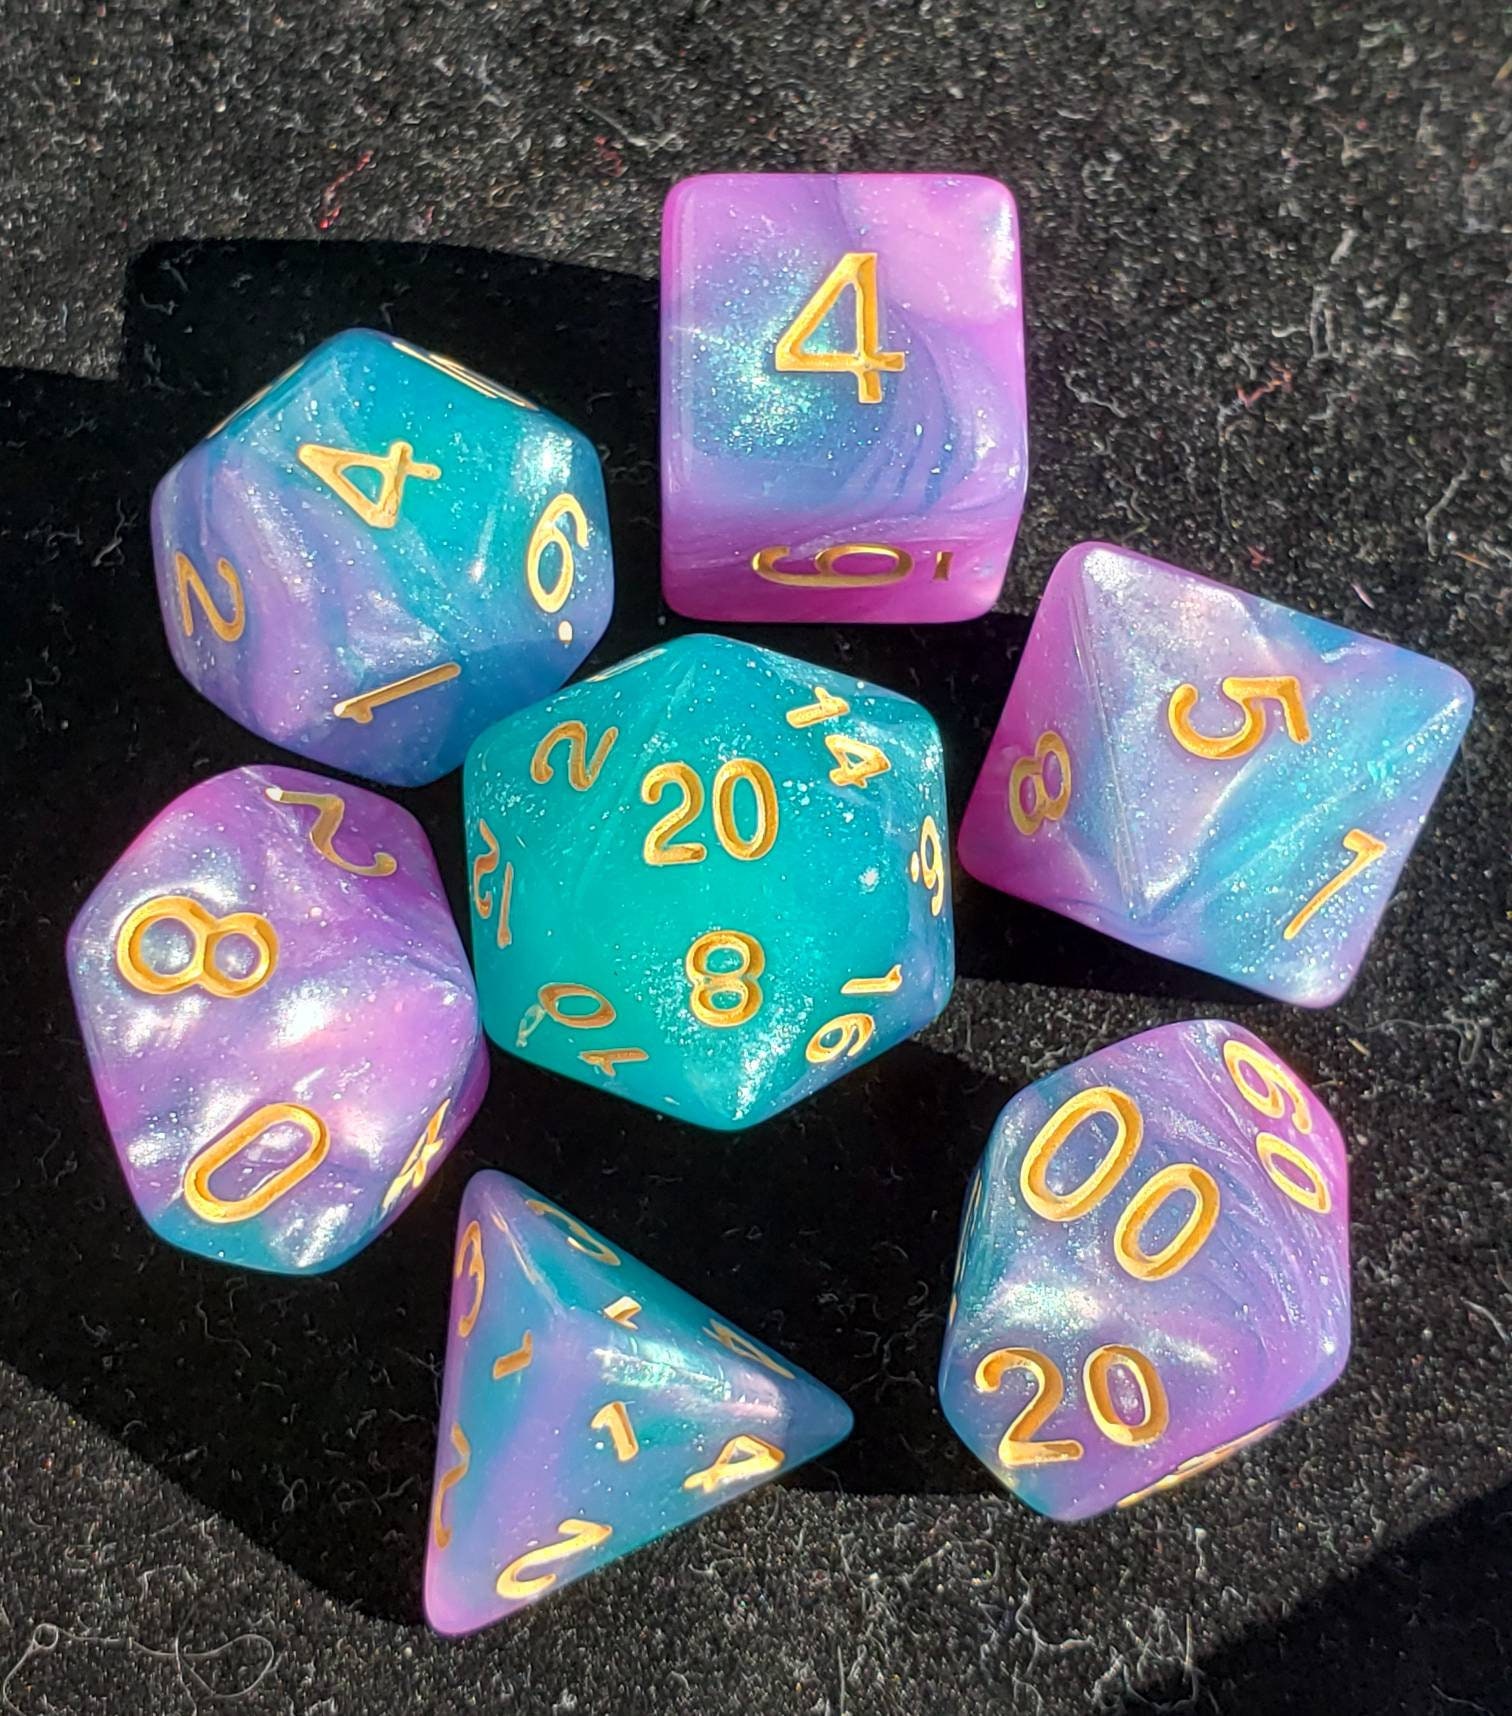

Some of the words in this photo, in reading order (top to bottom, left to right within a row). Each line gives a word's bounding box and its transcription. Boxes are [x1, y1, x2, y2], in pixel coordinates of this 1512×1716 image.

[775, 252, 905, 404] 4
[297, 441, 441, 529] 4
[175, 552, 245, 641] 2
[334, 663, 461, 723] 1
[786, 687, 891, 788] 14
[1168, 676, 1311, 760] 5
[530, 721, 618, 791] 2
[1008, 730, 1071, 835] 8
[641, 758, 779, 866] 20
[1283, 829, 1386, 939] 1
[117, 896, 280, 998] 8
[686, 930, 765, 1027] 8
[538, 983, 649, 1076] 10
[184, 1102, 330, 1223] 0
[1019, 1086, 1220, 1281] 00
[455, 1220, 486, 1338] 3
[493, 1331, 533, 1380] 1
[591, 1401, 639, 1462] 1
[974, 1344, 1169, 1468] 20
[684, 1434, 785, 1494] 4
[496, 1518, 612, 1598] 2
